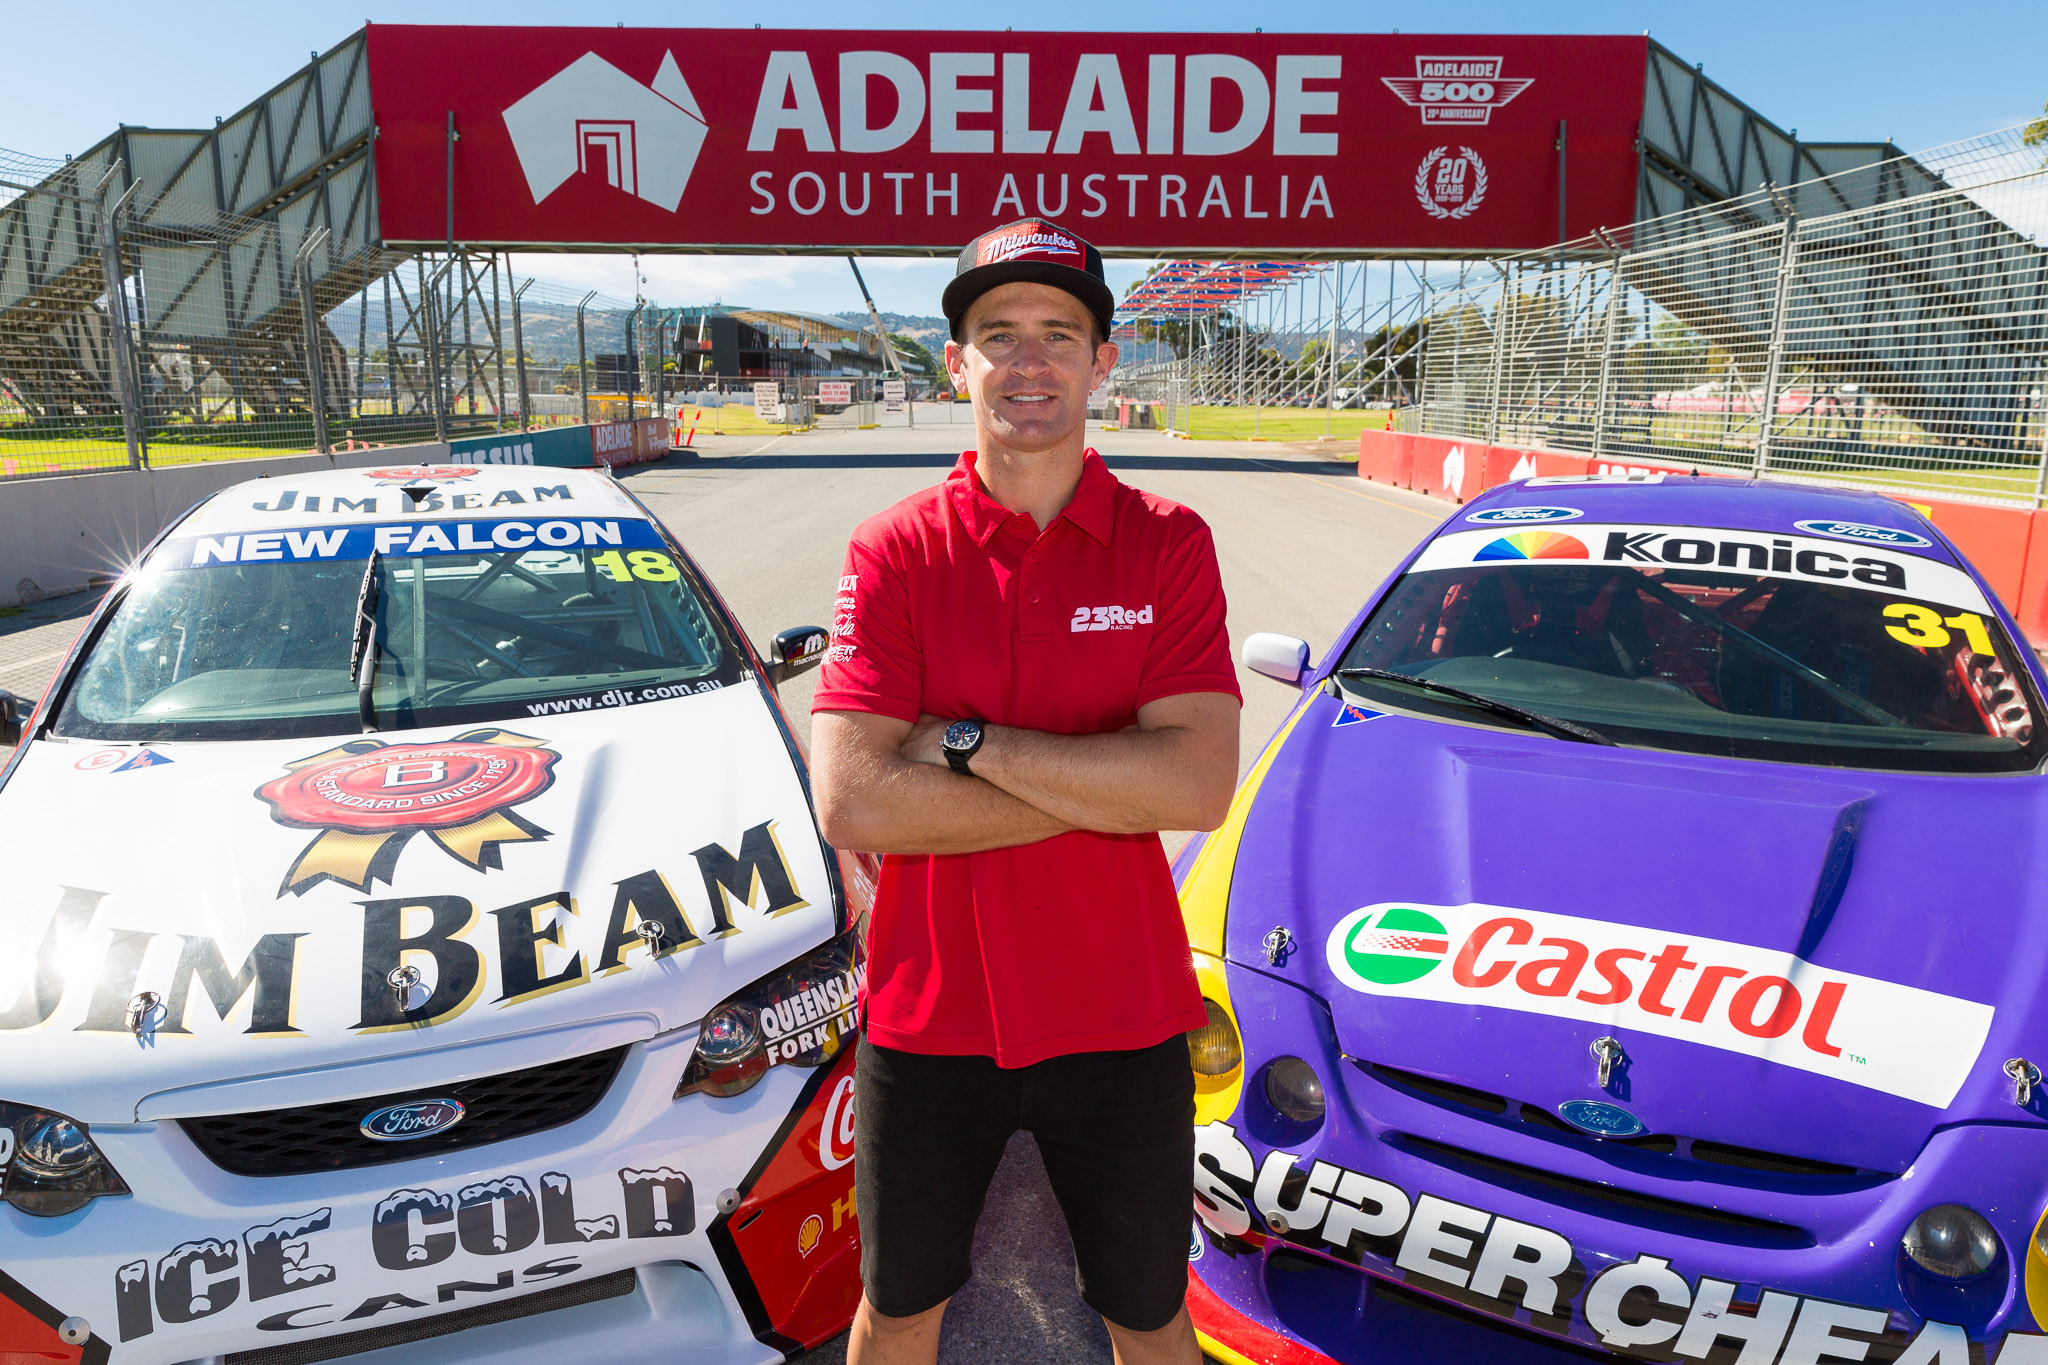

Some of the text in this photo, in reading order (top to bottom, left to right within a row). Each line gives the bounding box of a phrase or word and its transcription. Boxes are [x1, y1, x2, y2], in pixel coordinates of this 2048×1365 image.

[1422, 63, 1494, 77] ADELAIDE
[746, 50, 1342, 156] ADELAIDE
[1420, 82, 1495, 101] 500
[1436, 158, 1467, 184] 20
[750, 170, 1335, 219] SOUTH AUSTRALIA
[1435, 184, 1464, 195] YEARS
[985, 232, 1078, 262] Milwaukee
[596, 423, 633, 453] ADELAIDE
[252, 489, 379, 514] JIM
[400, 484, 577, 514] BEAM
[1492, 507, 1552, 522] Ford
[193, 521, 623, 566] NEW FALCON
[1828, 523, 1899, 543] Ford
[592, 550, 681, 583] 18
[1603, 531, 1907, 591] Konica
[1071, 604, 1153, 633] 23Red
[1882, 603, 1996, 657] 31
[527, 678, 724, 716] www.djr.com.au
[381, 761, 449, 788] B
[315, 780, 414, 810] STANDARD
[419, 780, 491, 806] SINCE
[0, 818, 811, 1039] JIM BEAM
[1451, 916, 1867, 1066] Castrol TM
[766, 1022, 831, 1067] FORK
[384, 1105, 442, 1133] Ford
[1578, 1105, 1623, 1129] Ford
[115, 1166, 697, 1344] ICE COLD
[256, 1255, 583, 1332] CANS
